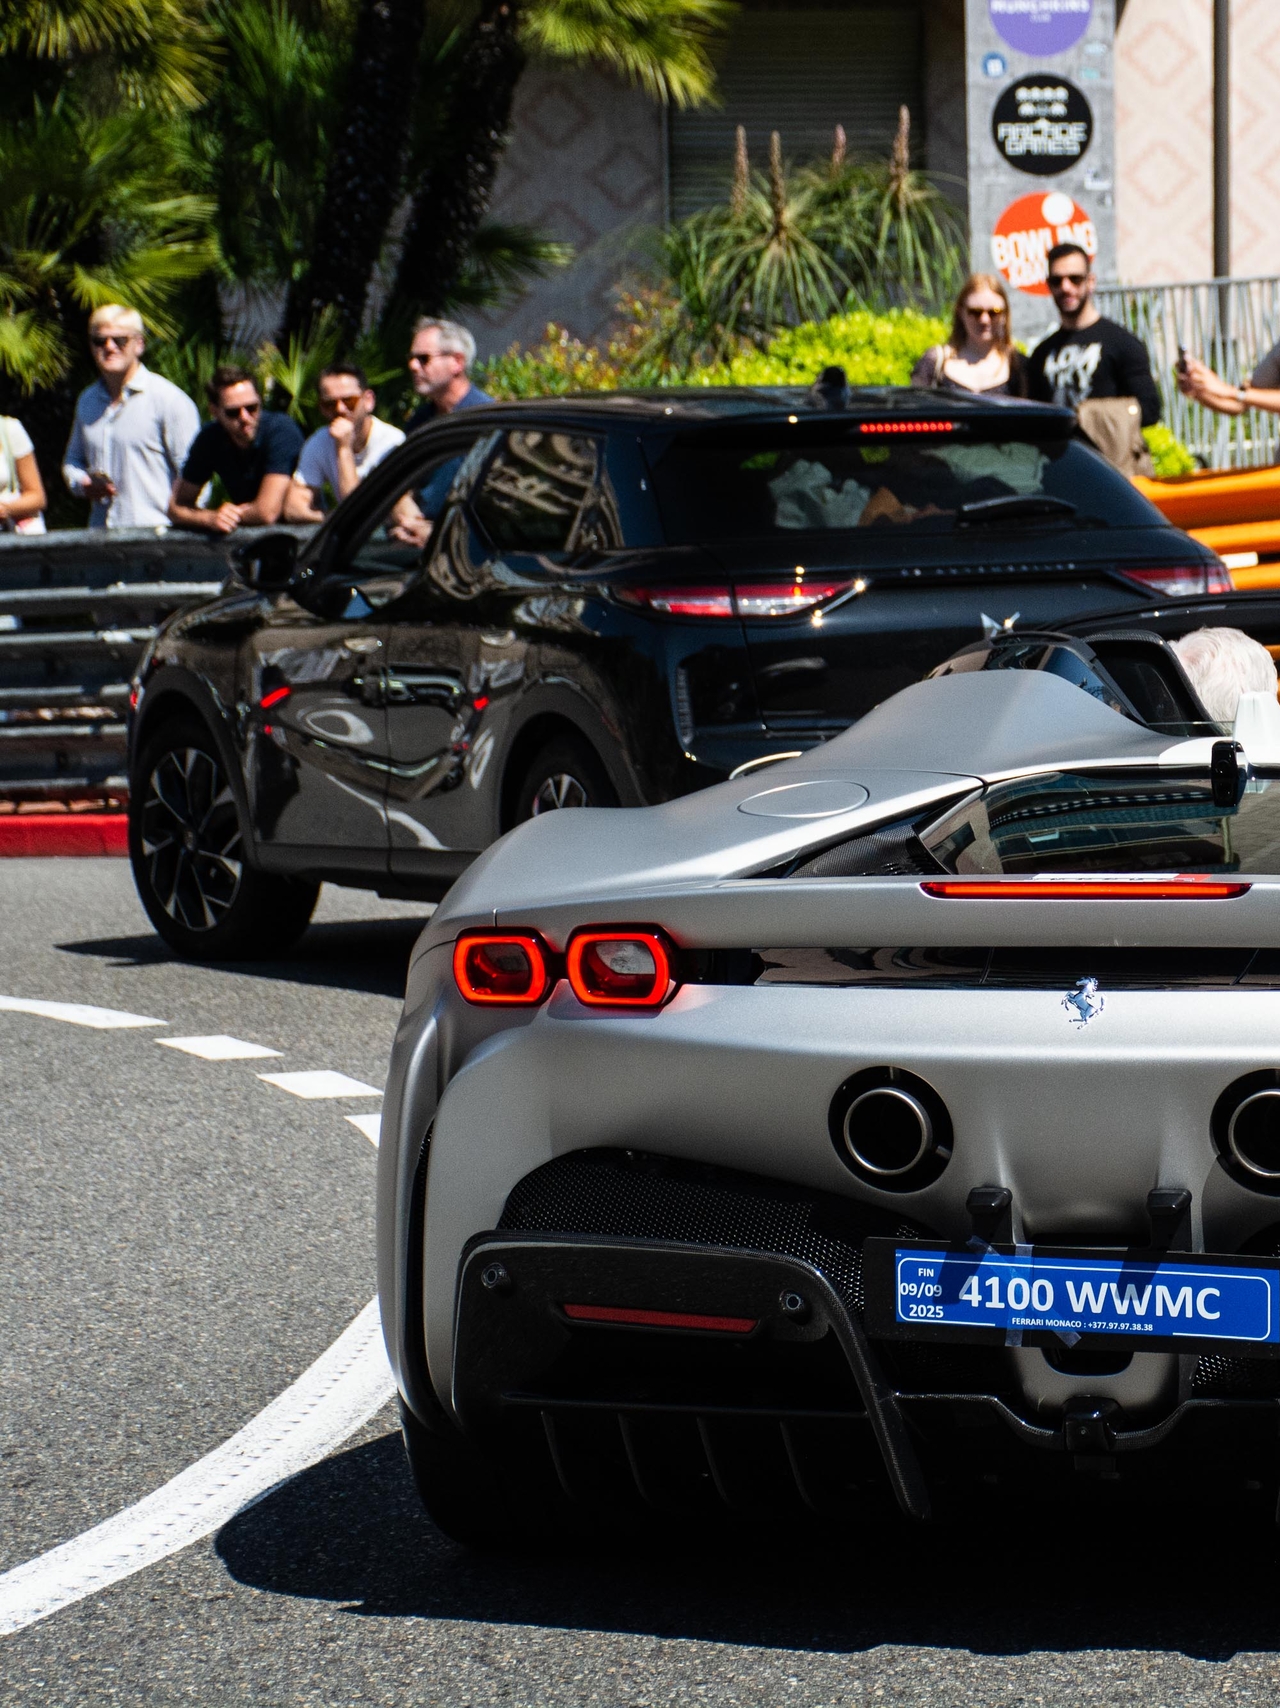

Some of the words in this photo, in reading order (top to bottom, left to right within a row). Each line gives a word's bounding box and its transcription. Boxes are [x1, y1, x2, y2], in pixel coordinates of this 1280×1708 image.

[997, 121, 1087, 141] ARCADE
[1005, 139, 1080, 155] GAMES
[918, 1267, 935, 1278] FIN
[900, 1282, 943, 1299] 09/09
[958, 1275, 1054, 1312] 4100
[1065, 1280, 1221, 1320] WWMC
[909, 1304, 944, 1319] 2025
[1011, 1317, 1044, 1326] FERRARI
[1045, 1319, 1082, 1328] MONACO
[1087, 1321, 1154, 1332] +377.97.97.38.38
